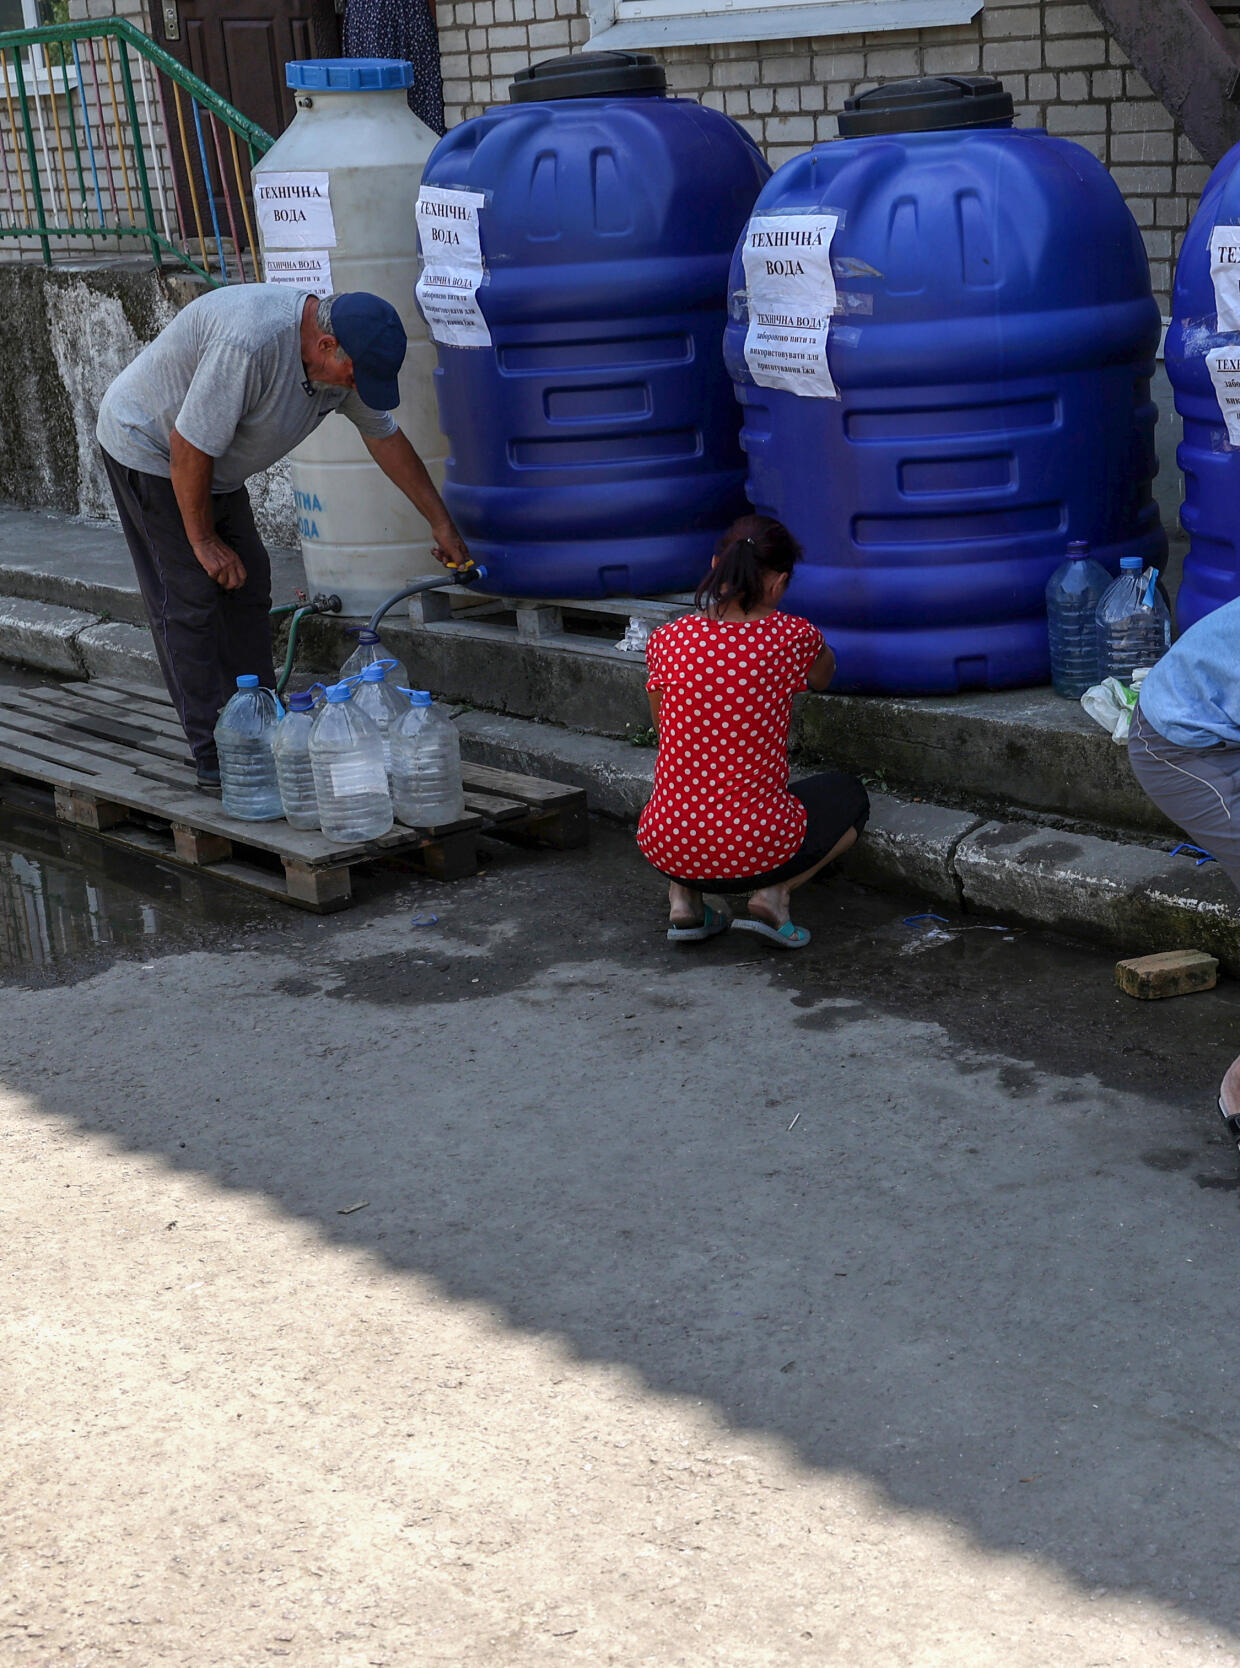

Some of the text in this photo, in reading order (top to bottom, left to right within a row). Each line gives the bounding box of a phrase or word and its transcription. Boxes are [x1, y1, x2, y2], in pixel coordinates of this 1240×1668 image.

[259, 185, 322, 199] ТЕХНІЧНА
[274, 209, 307, 223] ВОДА
[432, 228, 460, 246] ВОДА
[751, 231, 822, 248] ТЕХНІЧНА
[298, 260, 322, 270] ВОДА
[766, 260, 804, 277] ВОДА
[452, 277, 472, 288] ВОДА
[757, 313, 822, 328] ТЕХНІЧНА ВОДА
